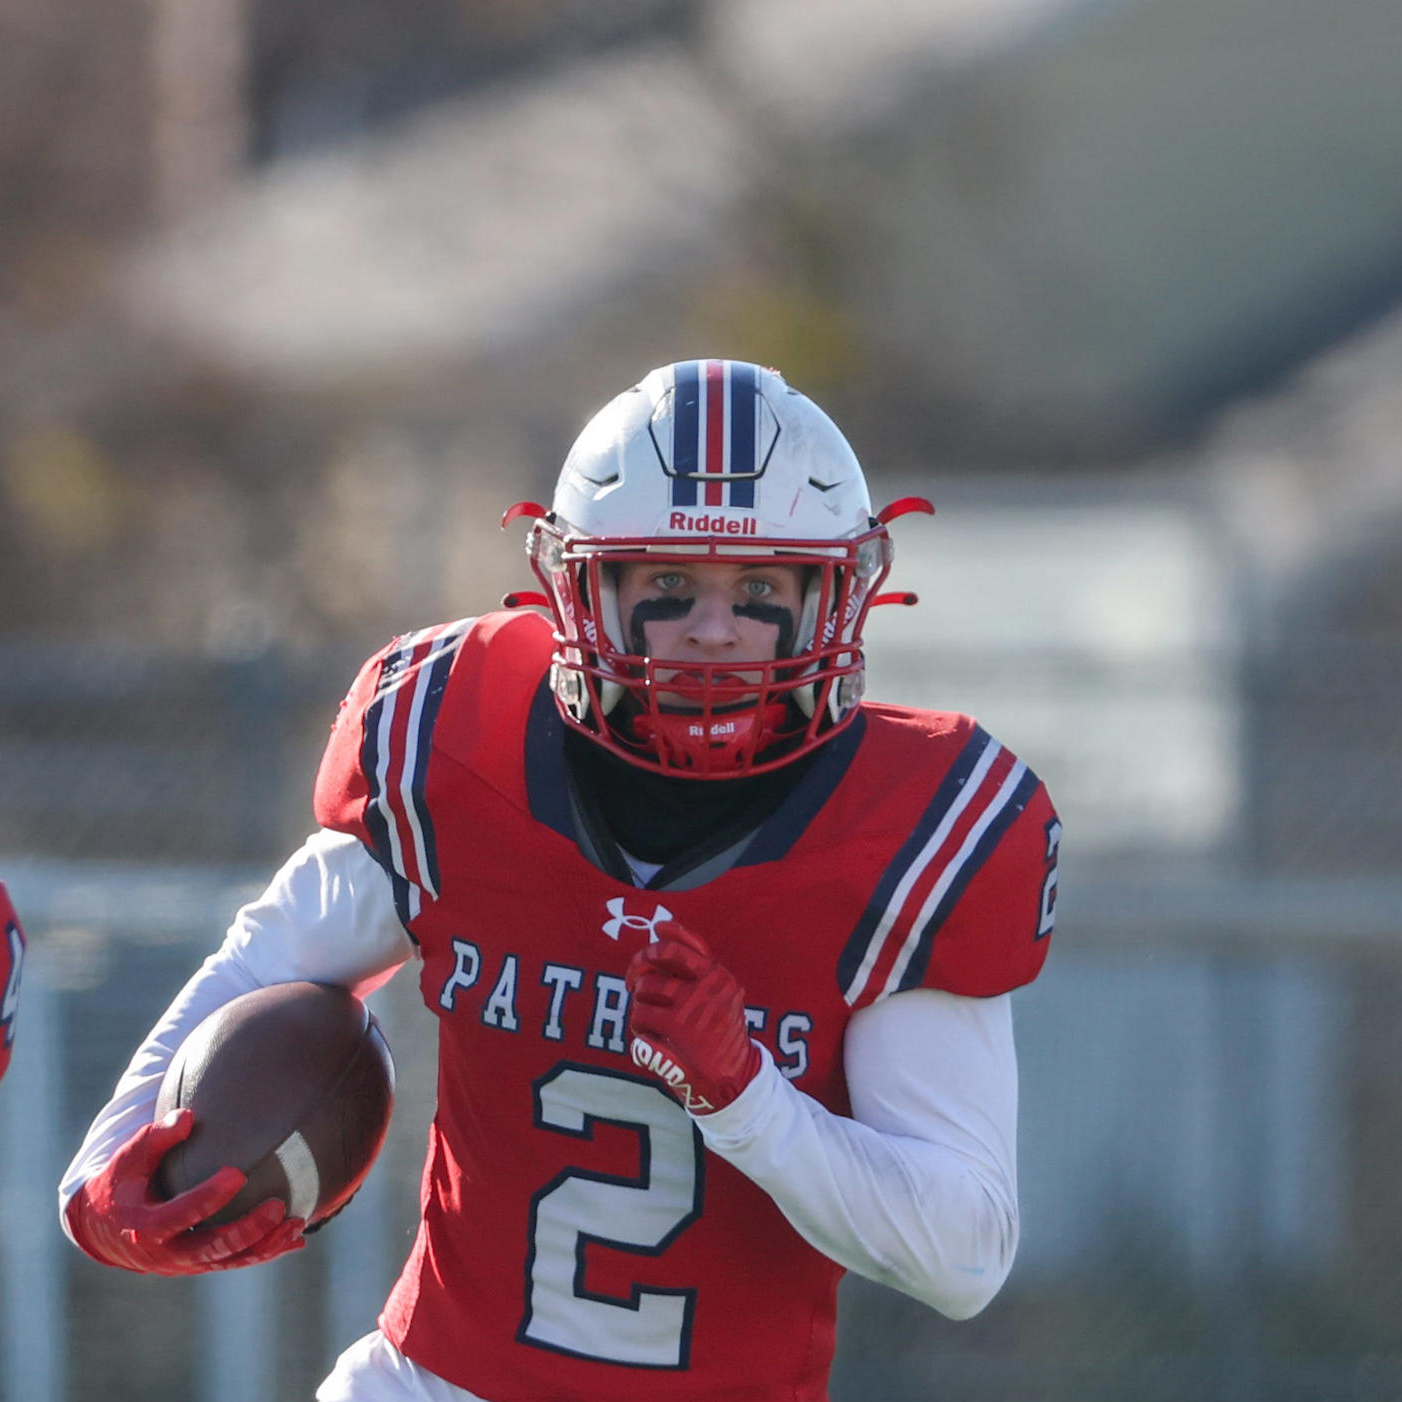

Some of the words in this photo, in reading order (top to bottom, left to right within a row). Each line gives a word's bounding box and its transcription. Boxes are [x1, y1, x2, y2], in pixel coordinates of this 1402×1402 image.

[670, 511, 756, 535] Riddell
[689, 722, 735, 737] Ridell
[438, 935, 815, 1082] PATRS
[515, 1059, 705, 1371] 2
